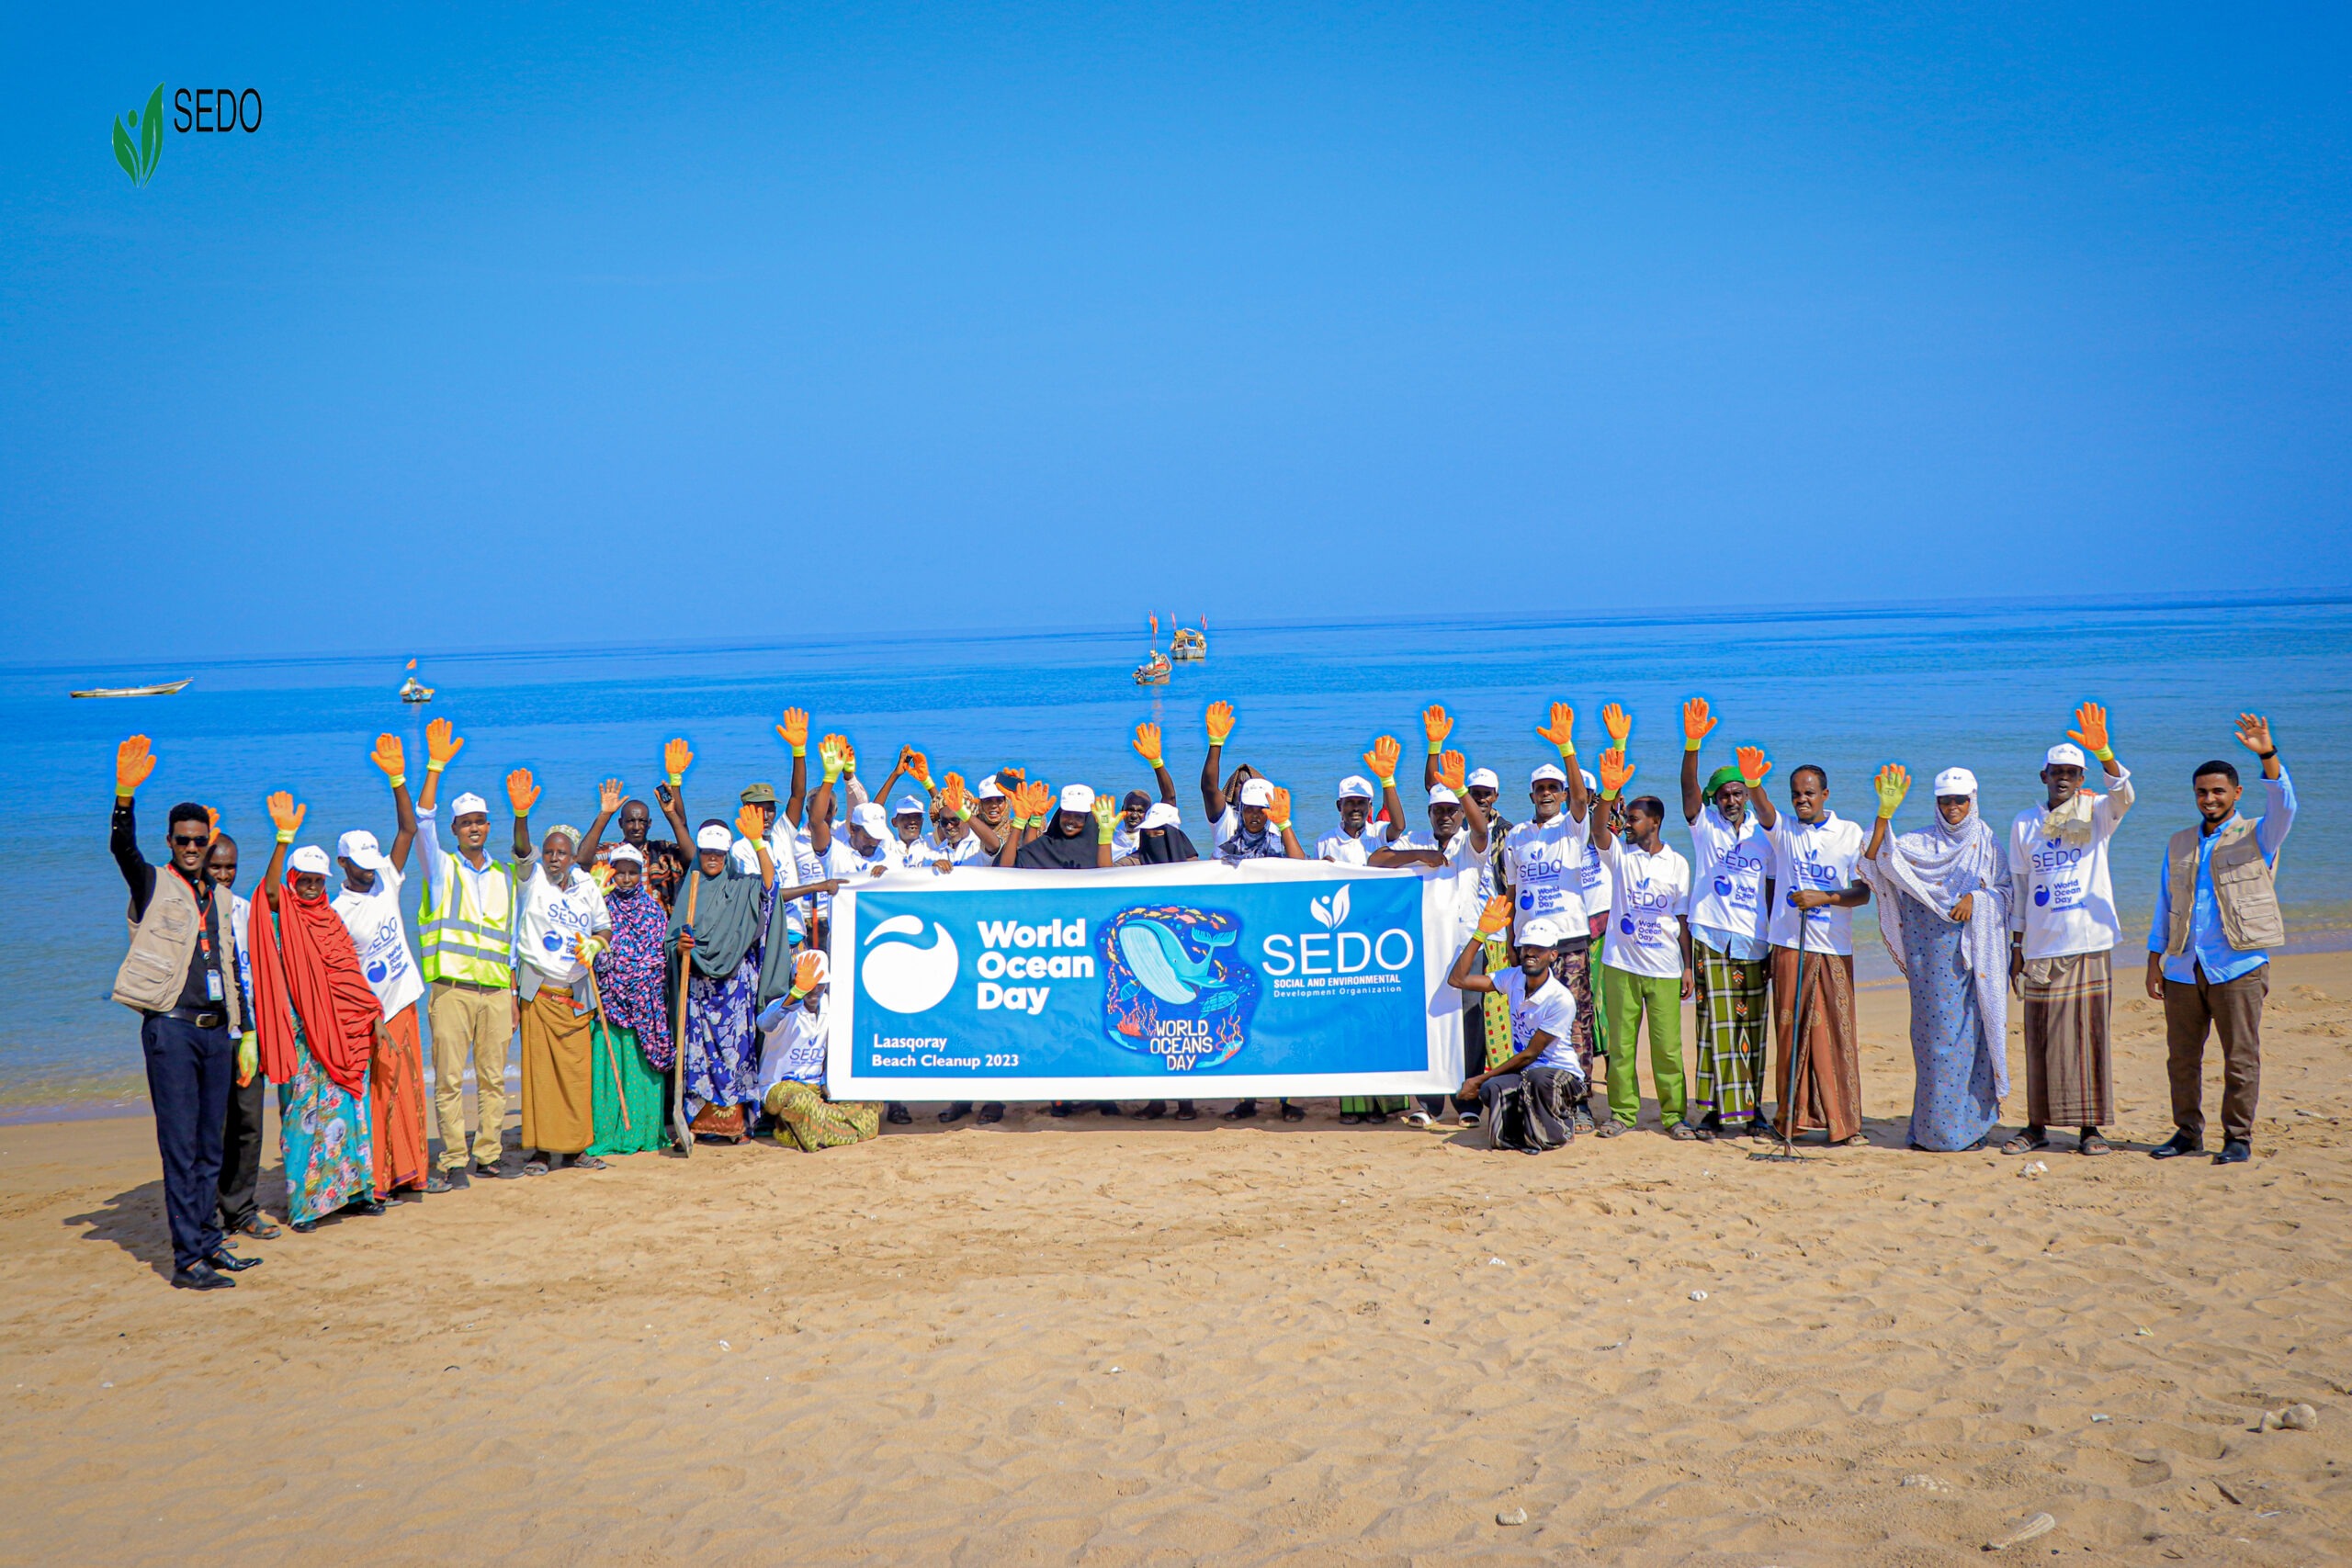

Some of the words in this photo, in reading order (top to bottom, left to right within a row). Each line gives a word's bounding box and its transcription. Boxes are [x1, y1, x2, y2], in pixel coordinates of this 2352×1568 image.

[2031, 848, 2082, 869] SEDO
[1520, 860, 1562, 878] SEDO
[1537, 886, 1560, 895] World
[2053, 879, 2079, 890] World
[2053, 887, 2082, 897] Ocean
[1538, 892, 1563, 901] Ocean
[2054, 896, 2073, 905] Day
[548, 903, 589, 928] SEDO
[977, 918, 1086, 948] World
[1261, 928, 1414, 976] SEDO
[977, 951, 1094, 979] Ocean
[1273, 977, 1305, 988] SOCIAL
[1307, 976, 1326, 987] AND
[1328, 974, 1401, 987] ENVIRONMENTAL
[977, 982, 1050, 1015] Day
[1273, 988, 1336, 998] Development
[1339, 986, 1402, 997] Organization
[1156, 1019, 1209, 1037] WORLD
[873, 1033, 947, 1053] Laasqoray
[1149, 1036, 1214, 1055] OCEANS
[872, 1054, 917, 1067] Beach
[921, 1054, 981, 1070] Cleanup
[985, 1054, 1019, 1067] 2023
[1167, 1055, 1196, 1072] DAY
